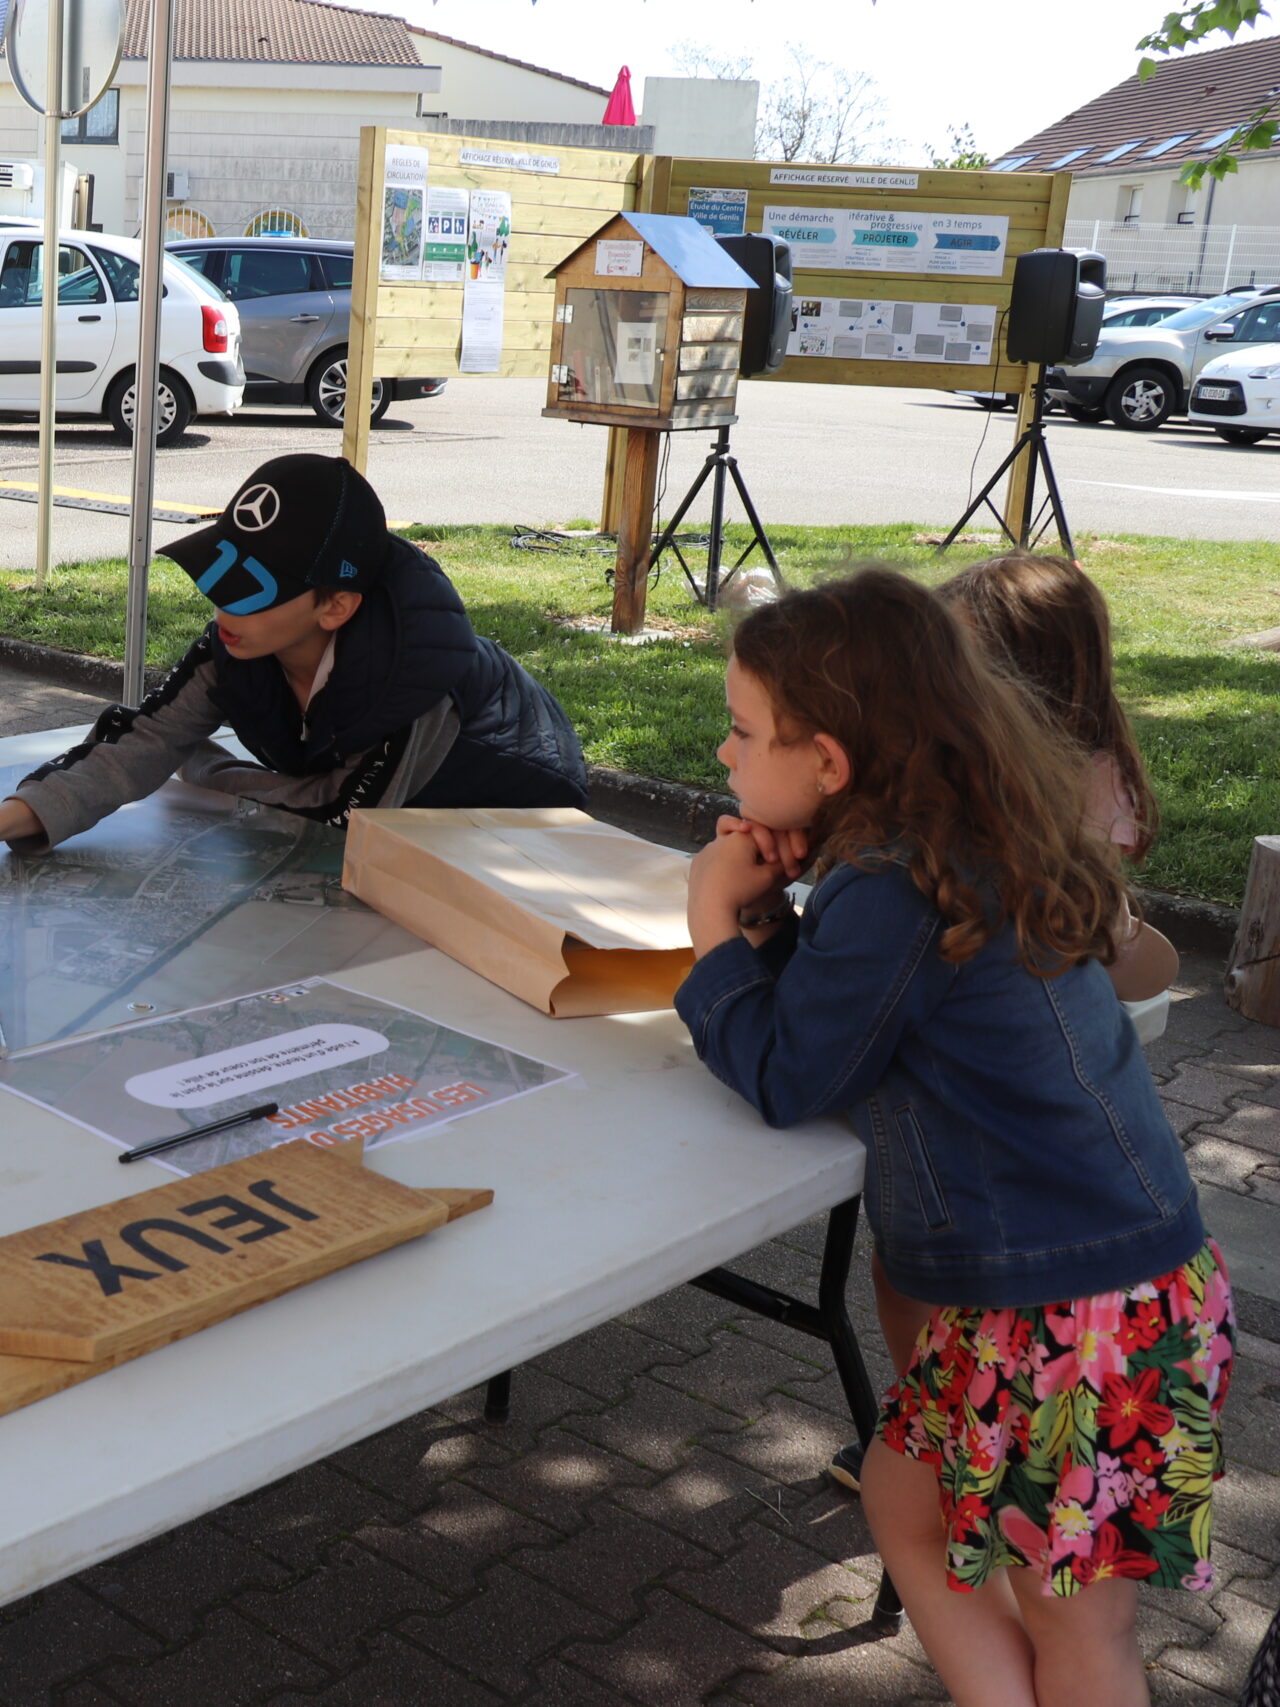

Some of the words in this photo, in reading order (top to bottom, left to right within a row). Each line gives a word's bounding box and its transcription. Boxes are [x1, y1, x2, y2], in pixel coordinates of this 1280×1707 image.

[461, 152, 491, 162] AFFICHAGE
[532, 159, 540, 167] DE
[386, 171, 424, 181] CIRCULATION
[773, 172, 816, 182] AFFICHAGE
[855, 176, 876, 185] VILLE
[877, 177, 888, 185] DE
[889, 178, 916, 187] GENLIS
[690, 202, 710, 212] Étude
[711, 203, 720, 212] du
[721, 204, 744, 213] Centre
[692, 211, 708, 220] Ville
[708, 212, 718, 220] de
[719, 212, 740, 222] Genlis
[768, 211, 787, 221] Une
[788, 211, 834, 223] démarche
[848, 211, 886, 222] itérative
[888, 213, 895, 222] &
[870, 221, 923, 232] progressive
[932, 220, 944, 228] en
[947, 219, 952, 228] 3
[953, 219, 983, 230] temps
[778, 229, 819, 241] RÉVÉLER
[862, 233, 908, 244] PROJETER
[950, 237, 973, 247] AGIR
[265, 1052, 280, 1060] de
[217, 1076, 234, 1085] sur
[180, 1084, 206, 1095] plan
[427, 1081, 492, 1106] LES
[265, 1073, 419, 1129] HABITANTS
[328, 1097, 446, 1140] USAGES
[32, 1178, 320, 1297] JEUX
